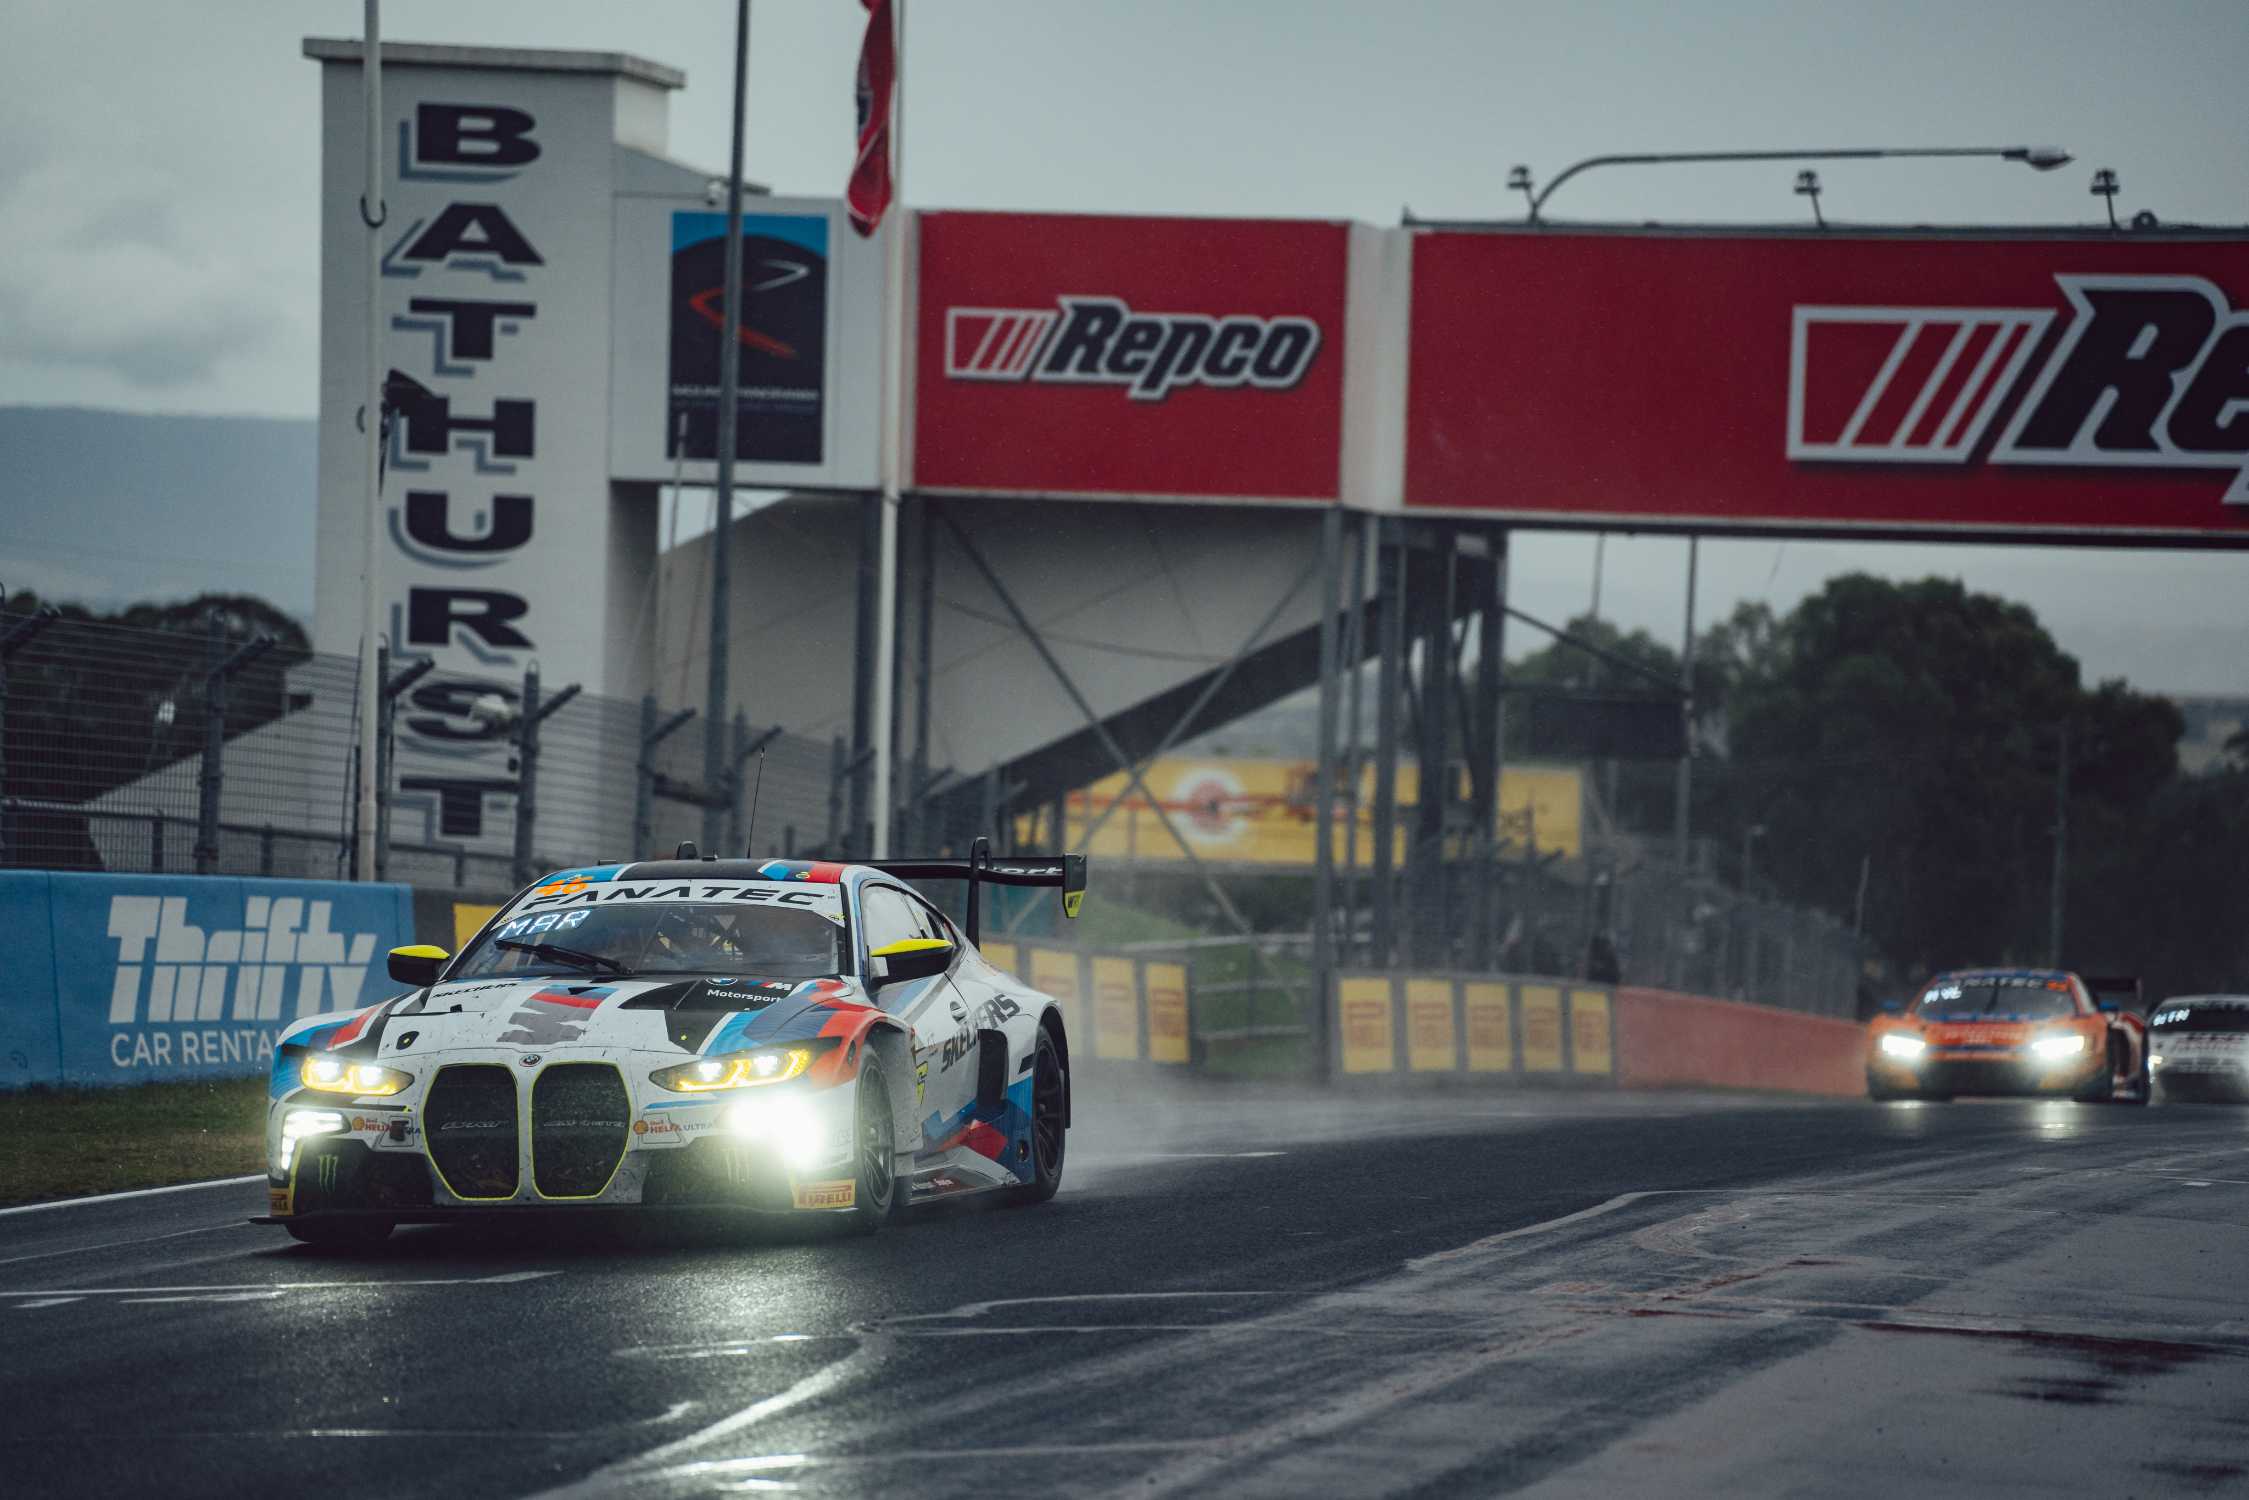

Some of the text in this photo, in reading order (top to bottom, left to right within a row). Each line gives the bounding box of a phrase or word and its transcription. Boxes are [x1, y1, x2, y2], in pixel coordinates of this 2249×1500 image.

[1032, 294, 1321, 400] Repco
[1989, 273, 2248, 504] Re
[400, 103, 545, 837] BATHURST
[497, 909, 591, 939] MAR
[520, 886, 825, 911] FANATEC
[107, 895, 378, 1023] Thrifty
[706, 988, 782, 1003] Motorsport
[111, 1030, 172, 1067] CAR
